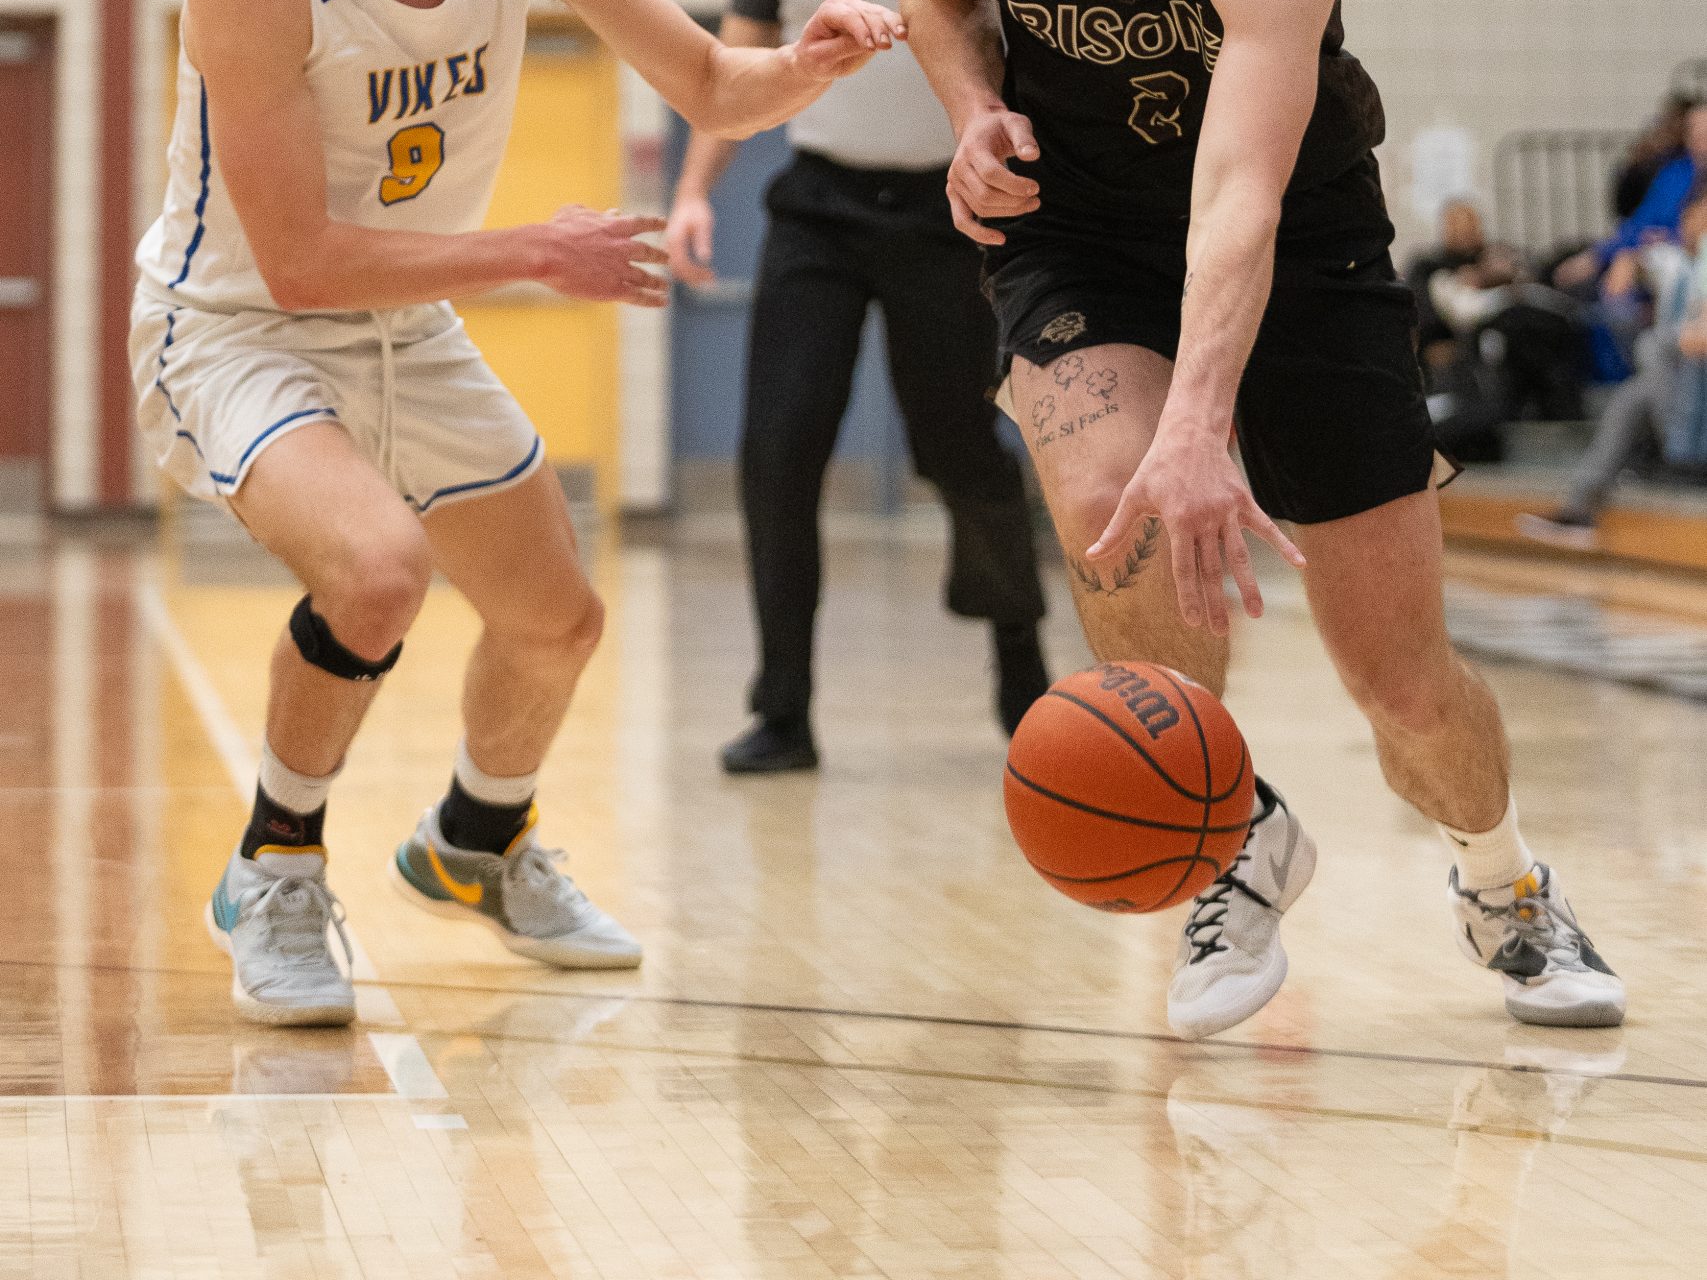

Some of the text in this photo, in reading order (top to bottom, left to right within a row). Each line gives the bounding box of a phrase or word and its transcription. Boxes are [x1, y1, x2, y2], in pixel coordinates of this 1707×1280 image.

[367, 42, 490, 124] VIKES
[1127, 70, 1190, 144] 2
[378, 121, 446, 206] 9
